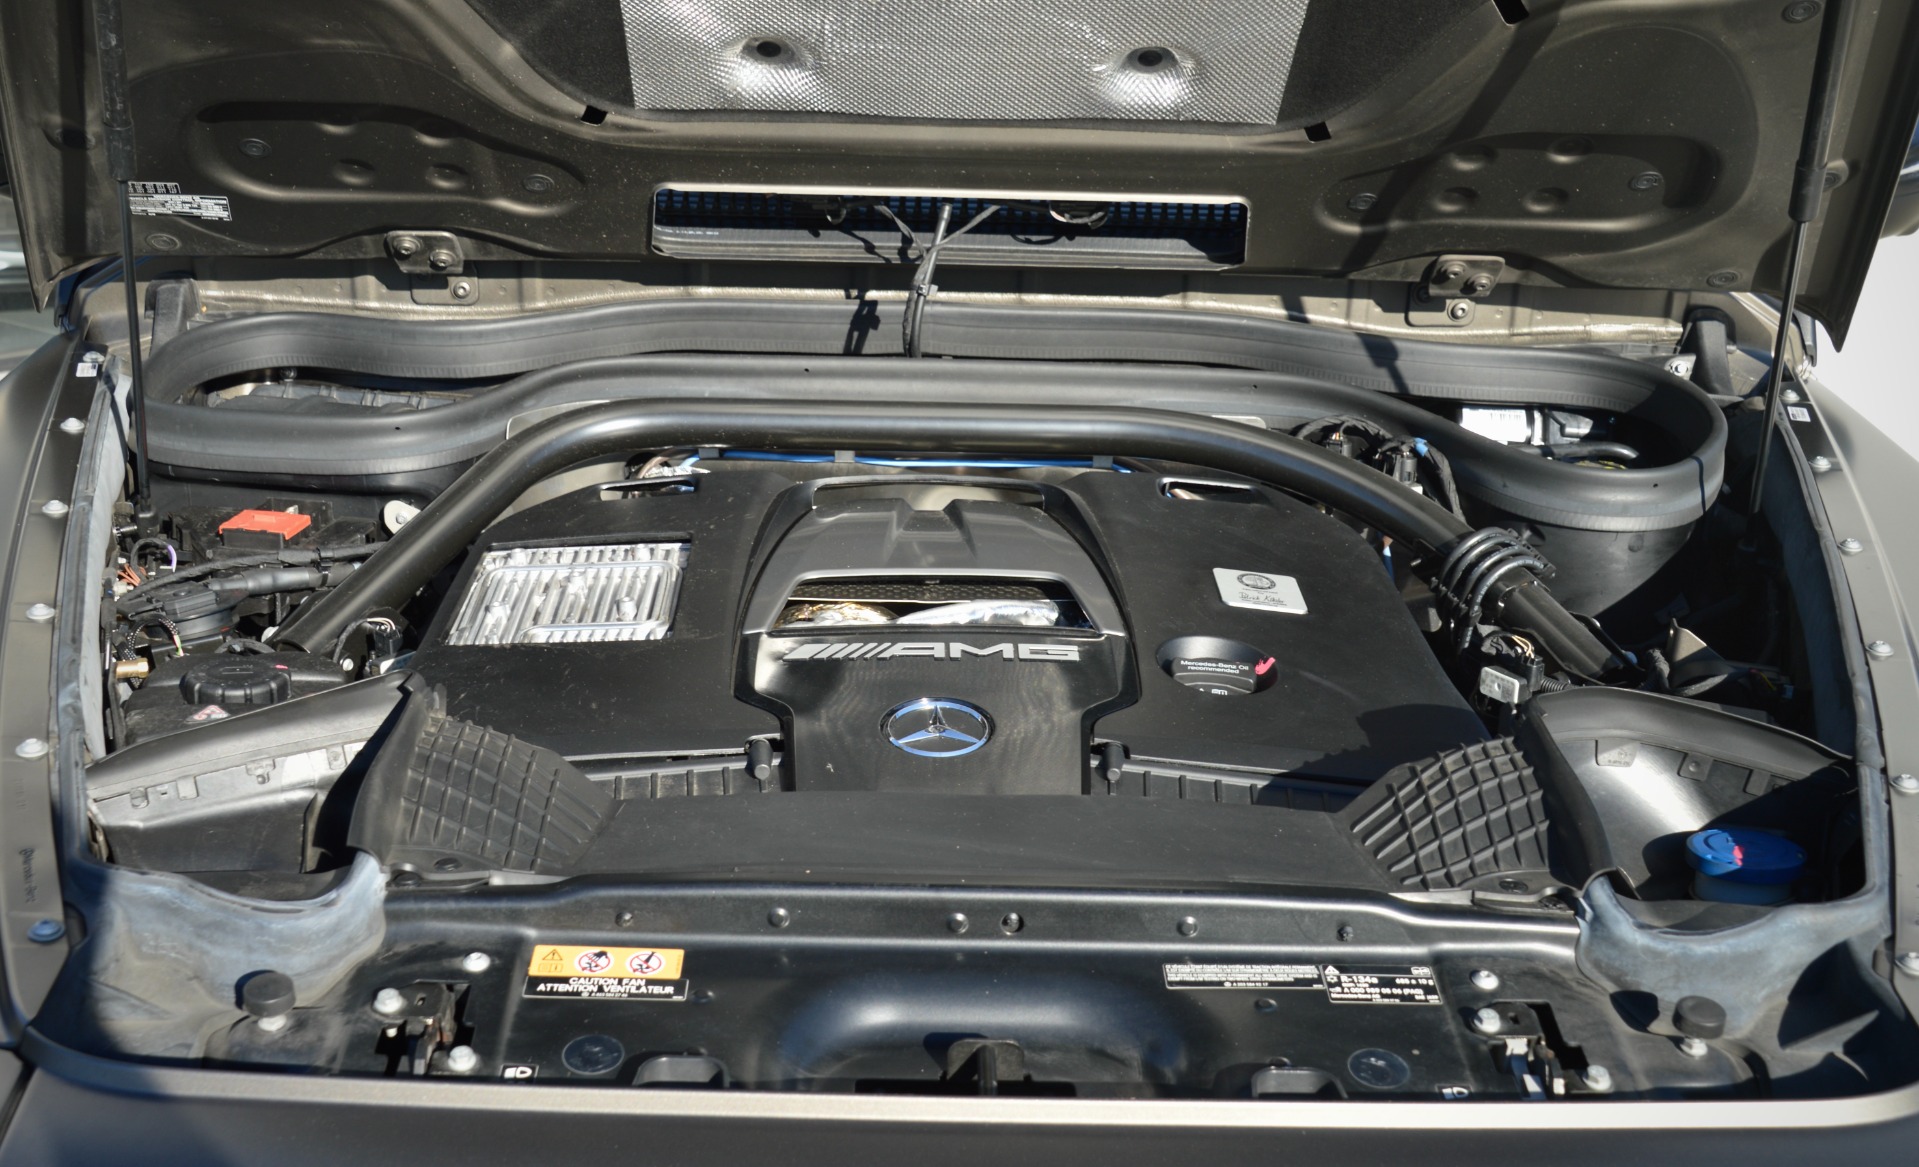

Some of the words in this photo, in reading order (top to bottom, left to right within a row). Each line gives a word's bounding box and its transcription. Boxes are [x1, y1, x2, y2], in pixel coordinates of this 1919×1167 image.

[1180, 660, 1237, 669] Mercedes-Benz
[1187, 666, 1240, 674] recommended
[569, 977, 619, 986] CAUTION
[622, 978, 646, 986] FAN
[1340, 975, 1379, 984] R-134a
[536, 983, 599, 992] ATTENTION
[603, 985, 674, 994] VENTILATEUR
